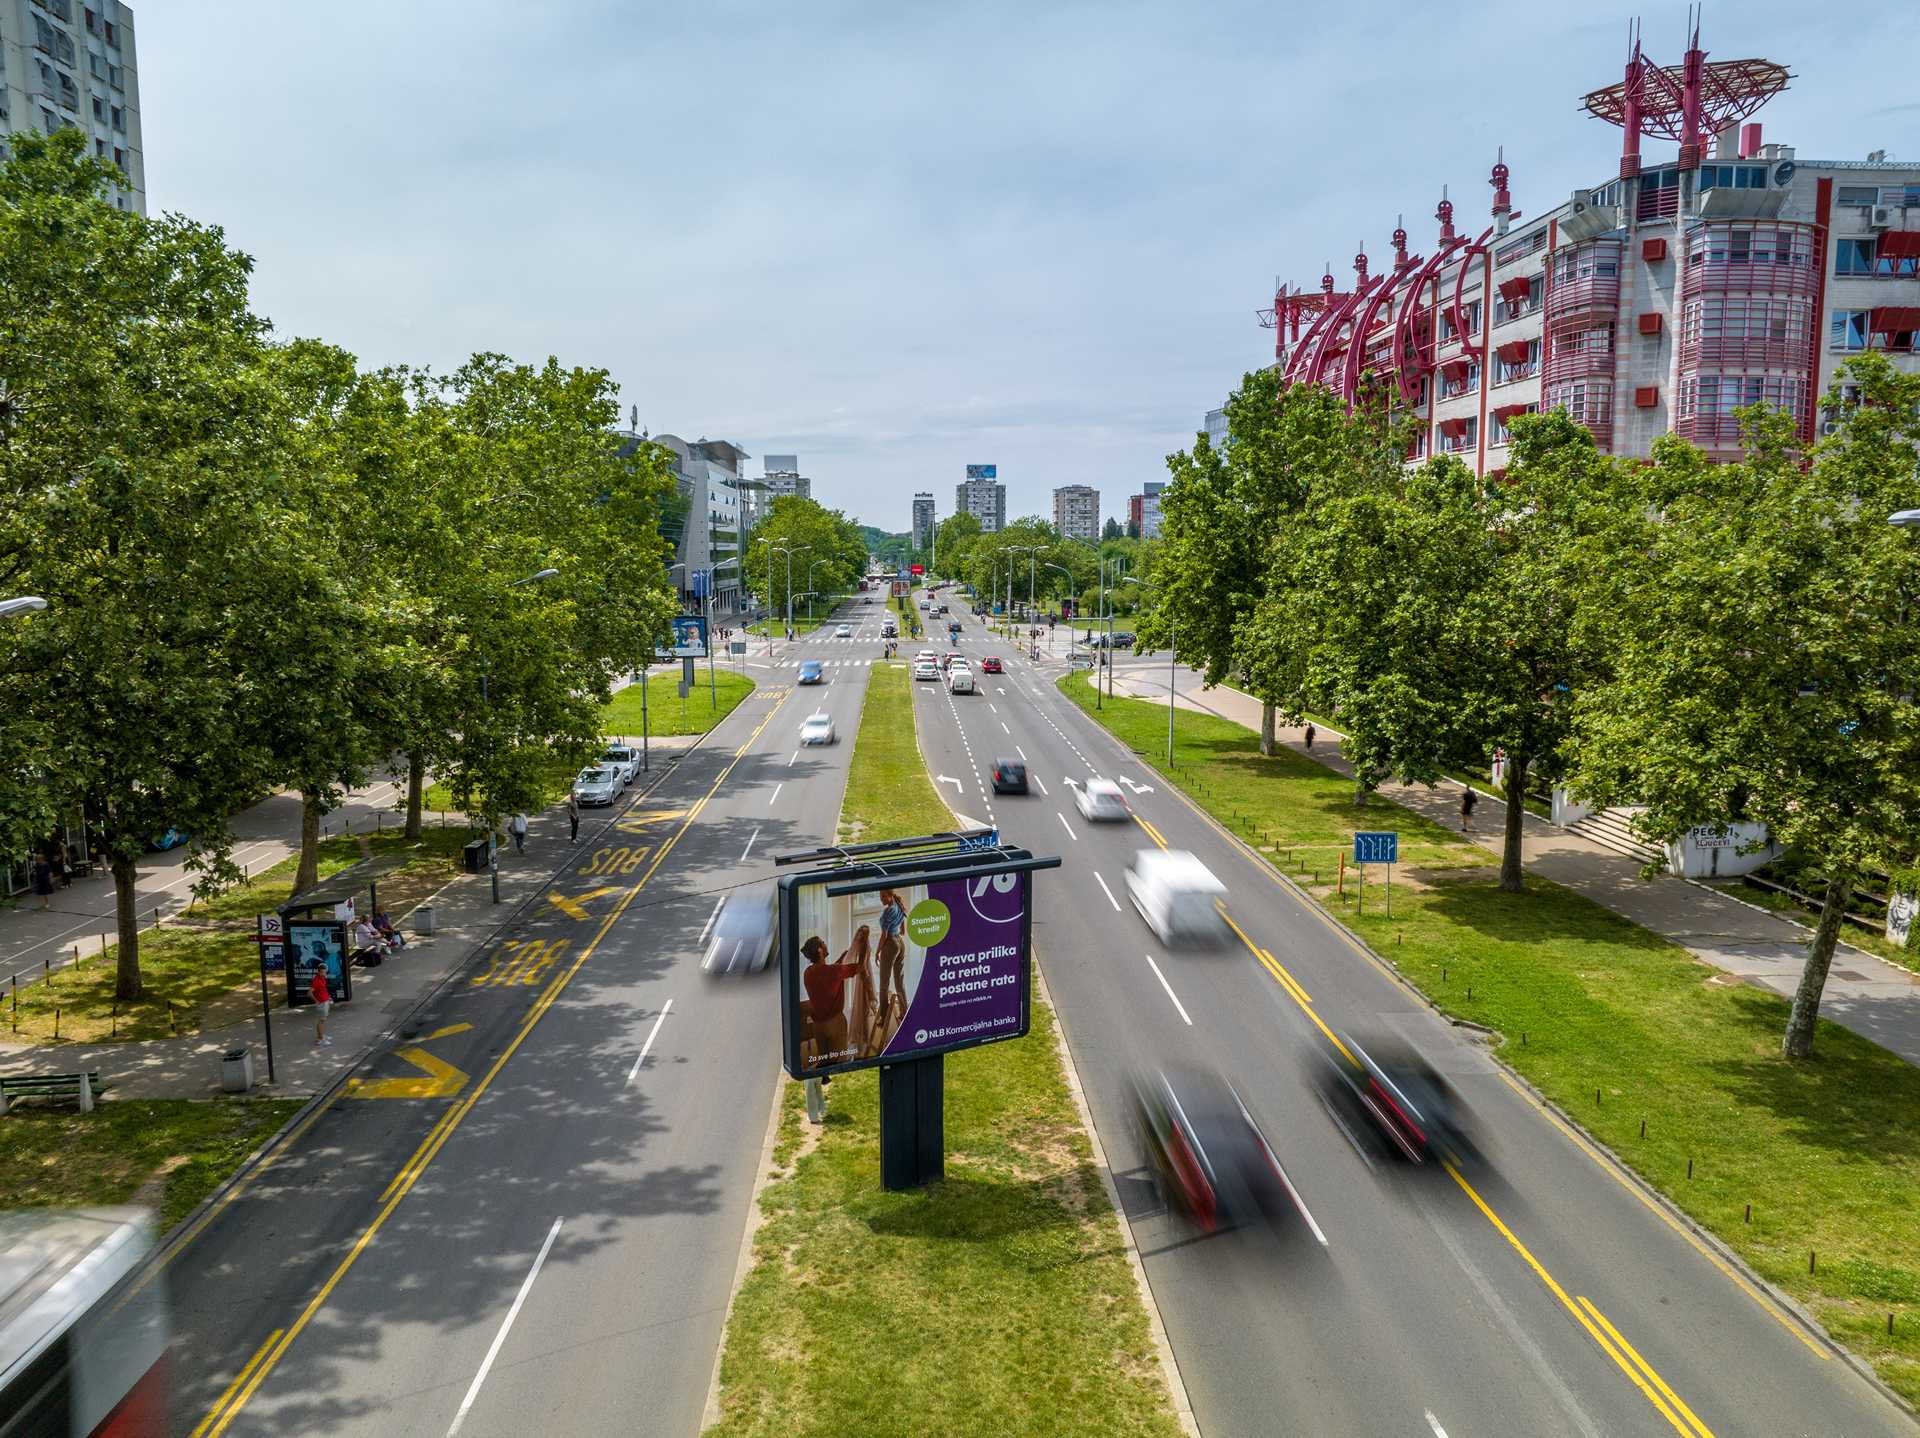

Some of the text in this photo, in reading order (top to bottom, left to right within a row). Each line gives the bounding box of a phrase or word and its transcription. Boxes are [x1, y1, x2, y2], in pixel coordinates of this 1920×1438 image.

[577, 847, 651, 876] BUS
[912, 912, 946, 925] Stambeni
[918, 925, 940, 934] kredit
[469, 938, 572, 986] BUS
[940, 946, 1016, 967] Prava prilika
[940, 964, 990, 981] da renta
[940, 974, 1015, 998] postane rata
[929, 1016, 1016, 1039] NLB Komercijalna banka
